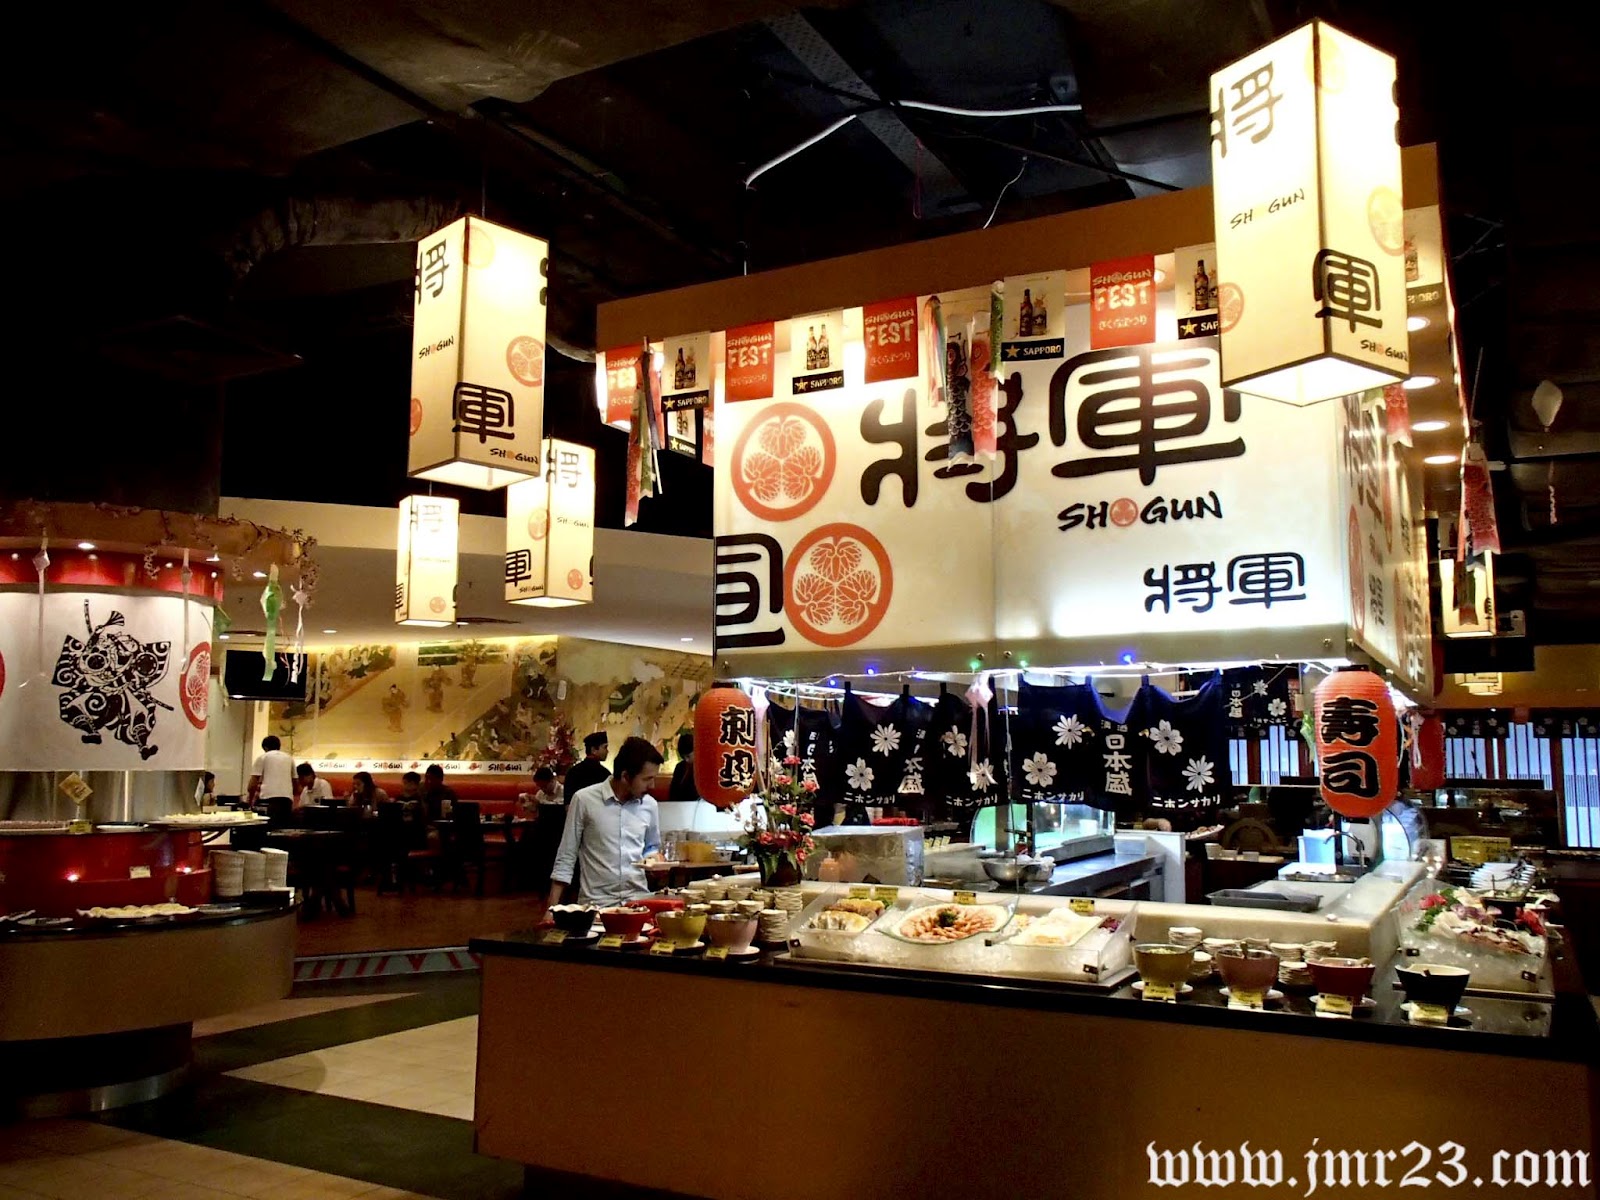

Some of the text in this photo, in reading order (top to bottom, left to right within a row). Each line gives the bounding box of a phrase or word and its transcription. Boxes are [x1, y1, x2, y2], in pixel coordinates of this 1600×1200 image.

[1093, 280, 1151, 312] FEST
[866, 320, 915, 348] FEST
[728, 343, 772, 369] FEST
[1023, 344, 1062, 356] SAPPORO
[810, 375, 843, 389] SAPPORO
[677, 395, 707, 408] SAPPORO
[1151, 794, 1221, 809] ニホンサカリ
